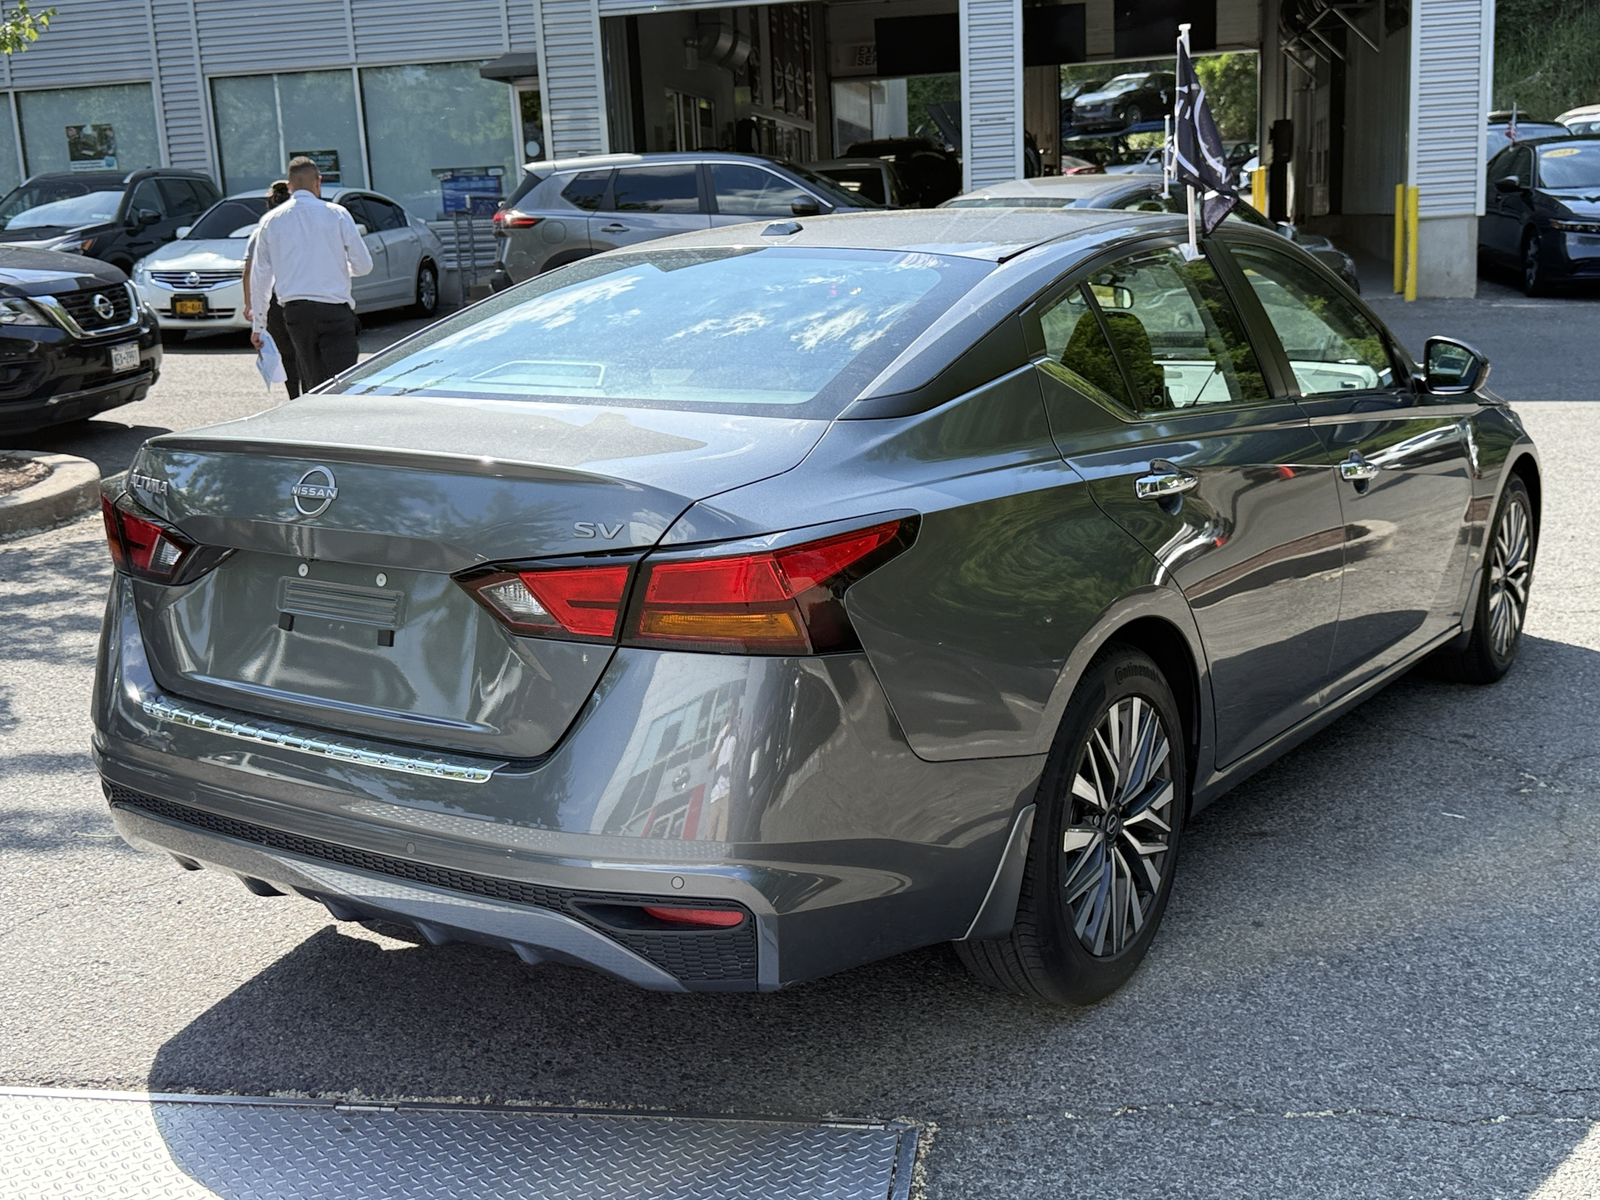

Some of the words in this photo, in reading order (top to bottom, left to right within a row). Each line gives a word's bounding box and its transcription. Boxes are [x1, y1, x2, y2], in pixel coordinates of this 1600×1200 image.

[291, 485, 337, 499] NISSAN
[573, 521, 624, 539] SV
[1115, 661, 1156, 686] Continental
